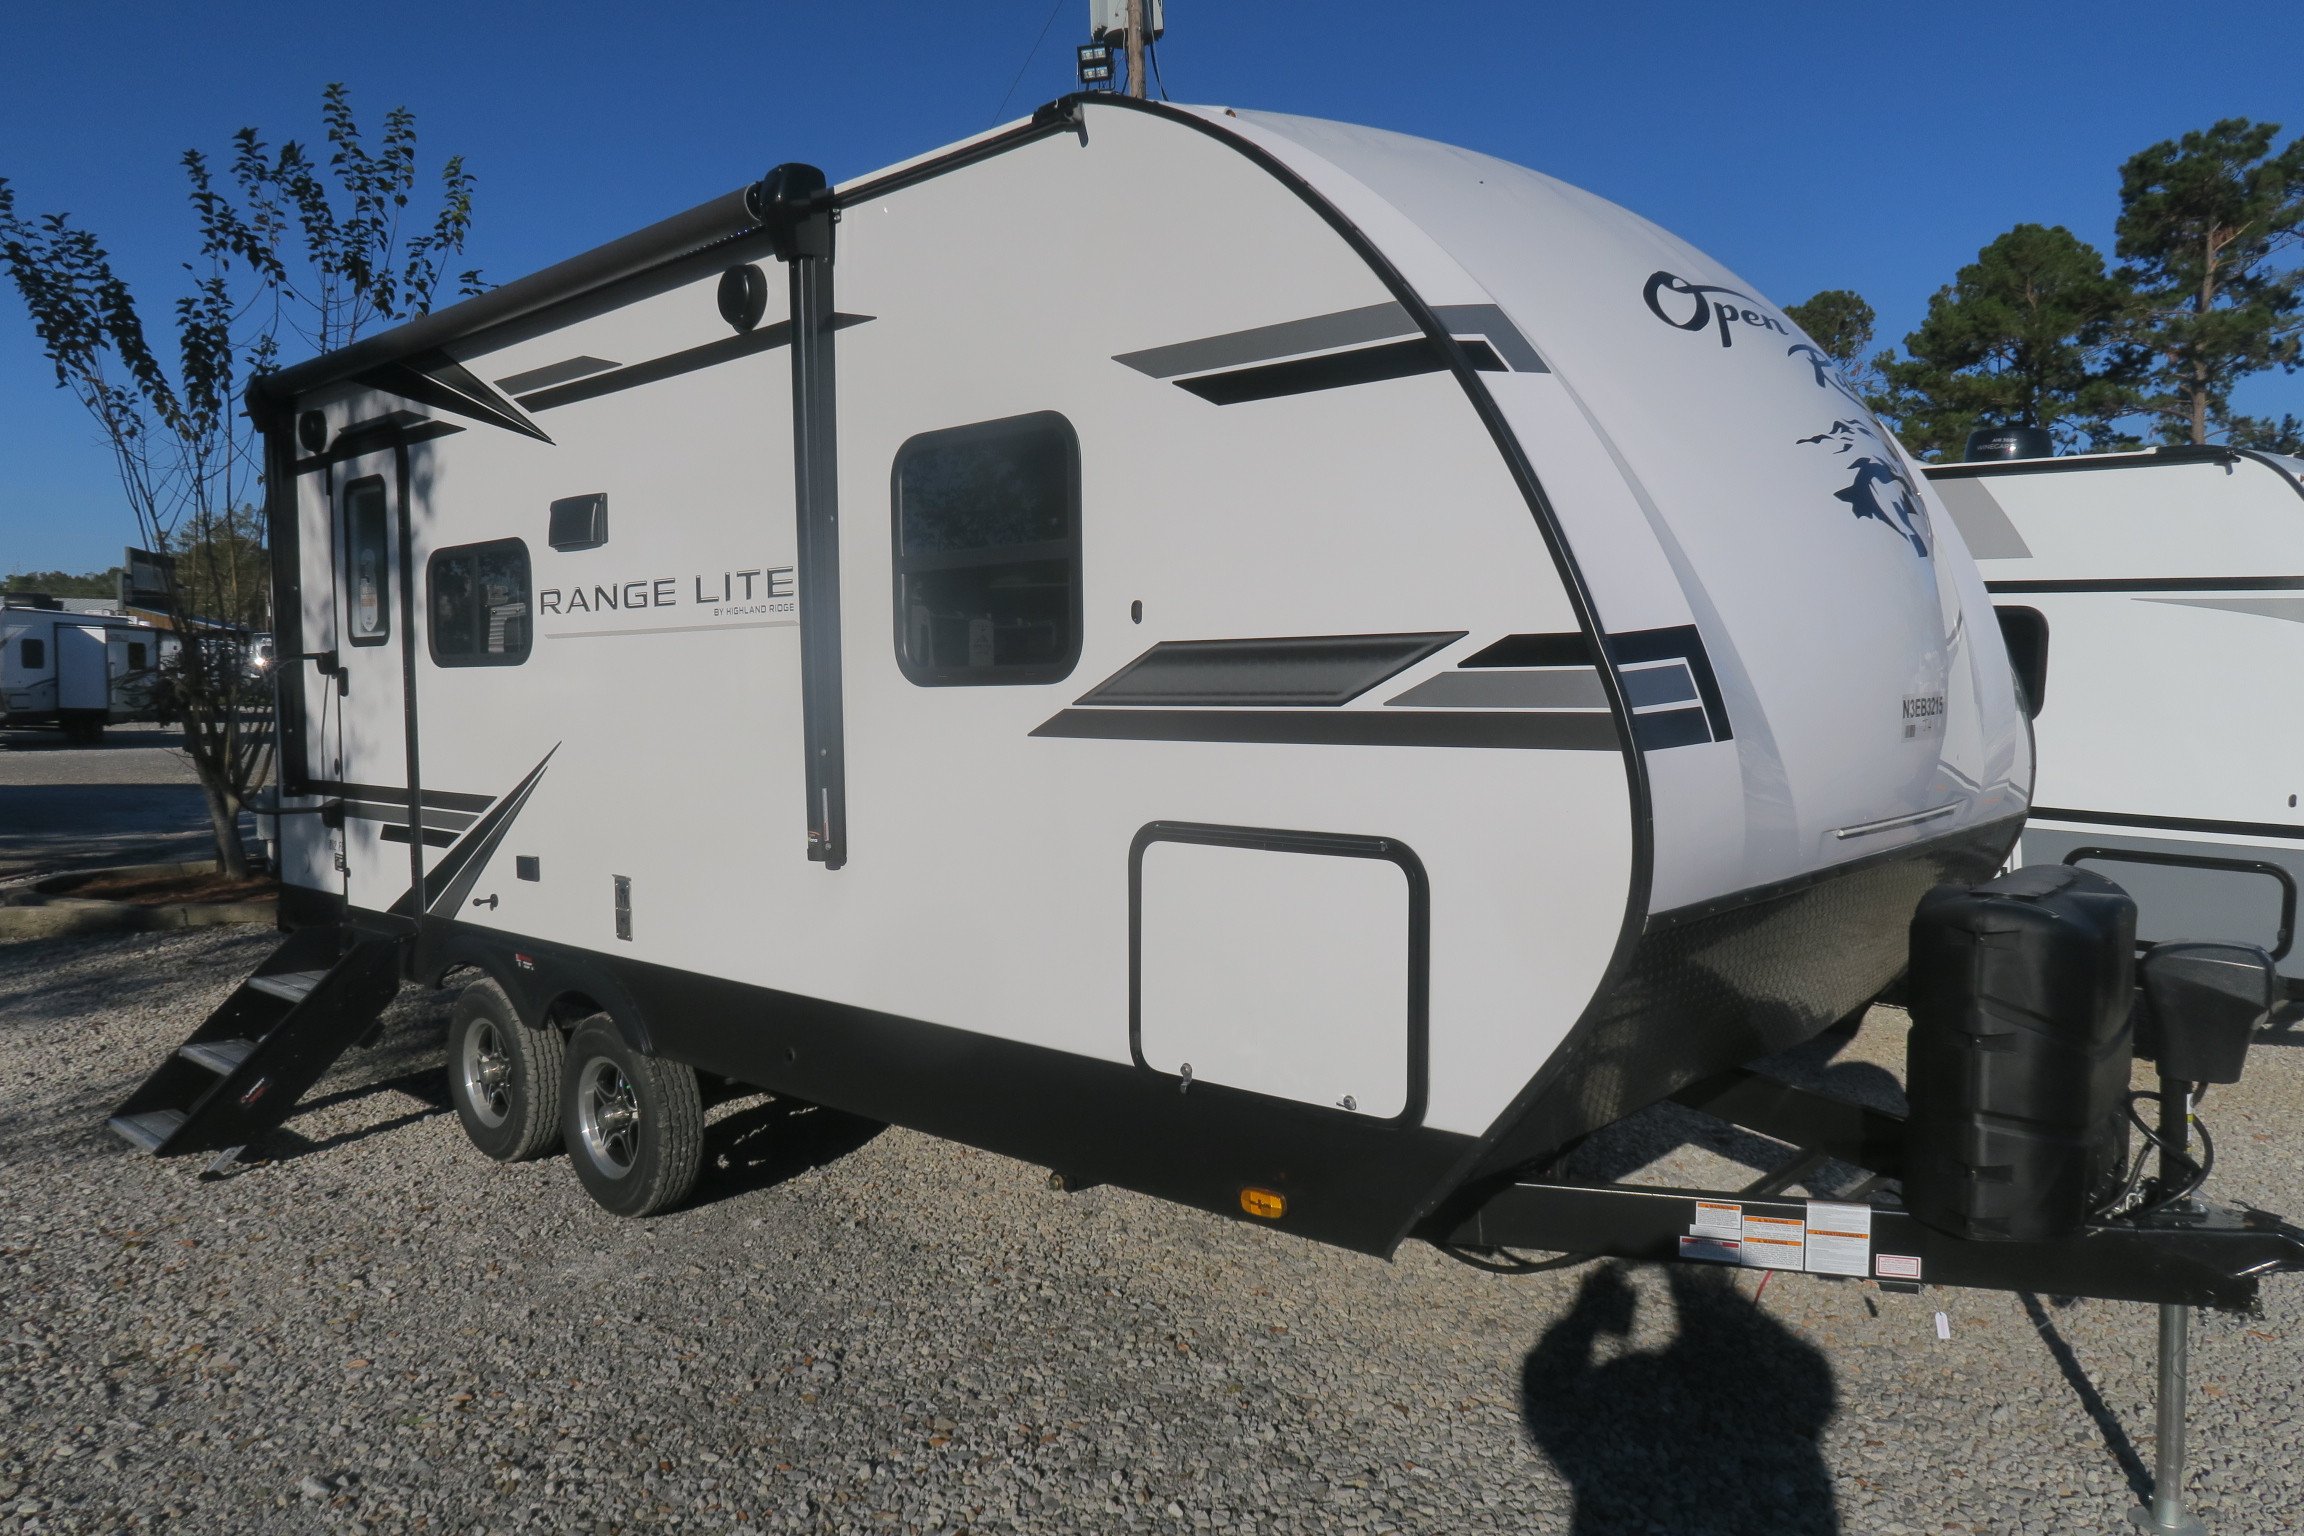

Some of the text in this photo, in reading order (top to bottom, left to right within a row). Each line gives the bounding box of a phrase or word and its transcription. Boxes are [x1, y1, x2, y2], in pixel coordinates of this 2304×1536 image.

[1643, 270, 1789, 347] Open
[540, 566, 794, 615] RANGE LITE
[714, 603, 794, 616] BY HIGHLAND RIDGE
